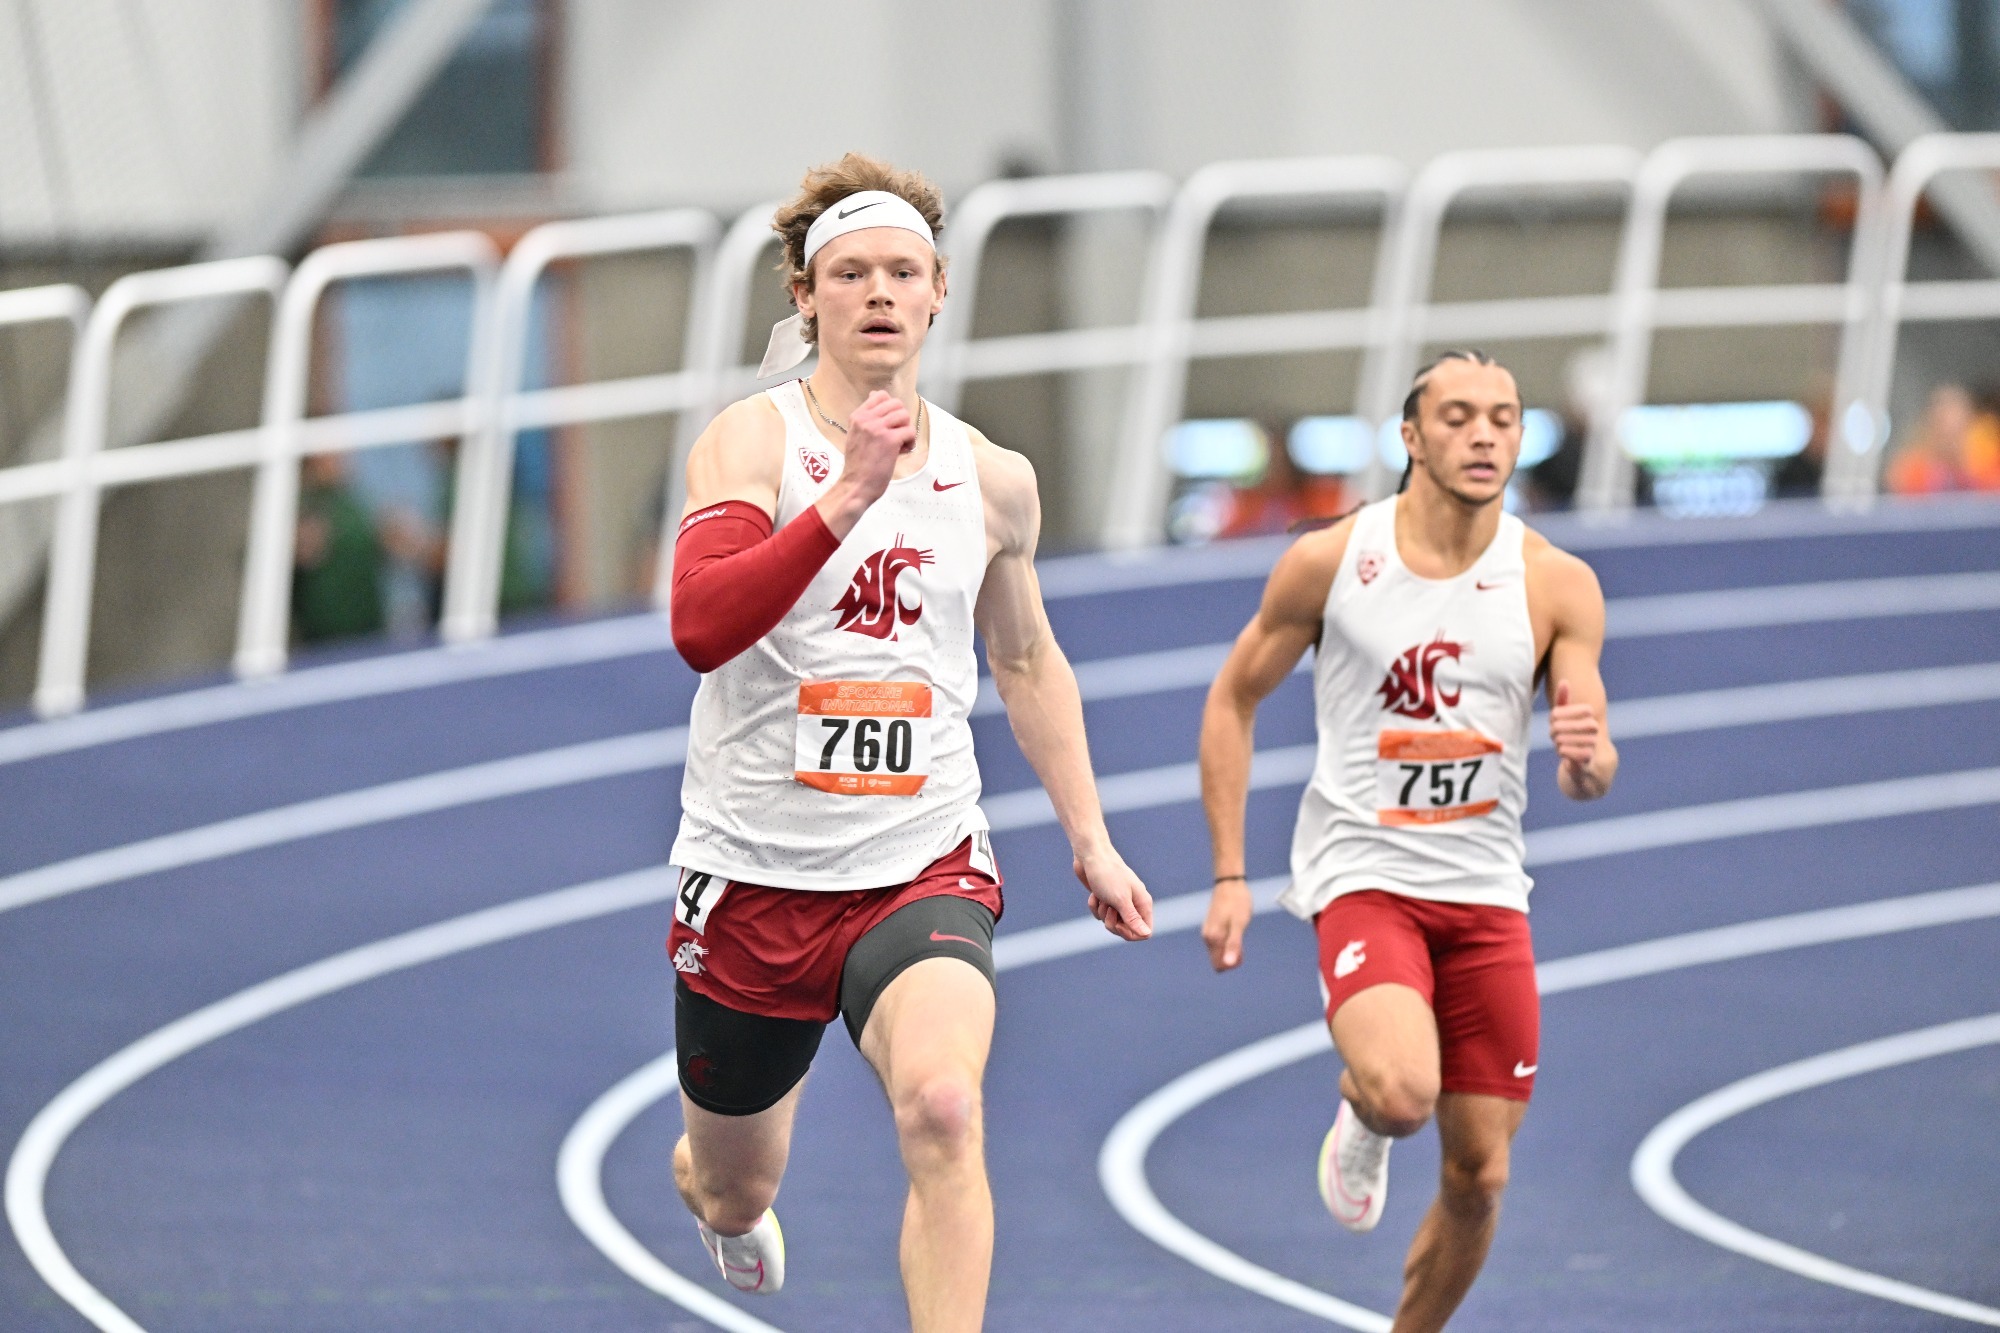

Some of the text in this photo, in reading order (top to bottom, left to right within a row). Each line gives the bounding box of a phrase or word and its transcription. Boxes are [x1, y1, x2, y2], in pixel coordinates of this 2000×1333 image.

[808, 462, 828, 478] 12
[820, 699, 915, 712] INVITATIONAL
[838, 686, 902, 698] SPOKANE
[819, 718, 912, 773] 760
[1398, 759, 1483, 807] 757
[680, 870, 714, 925] 4
